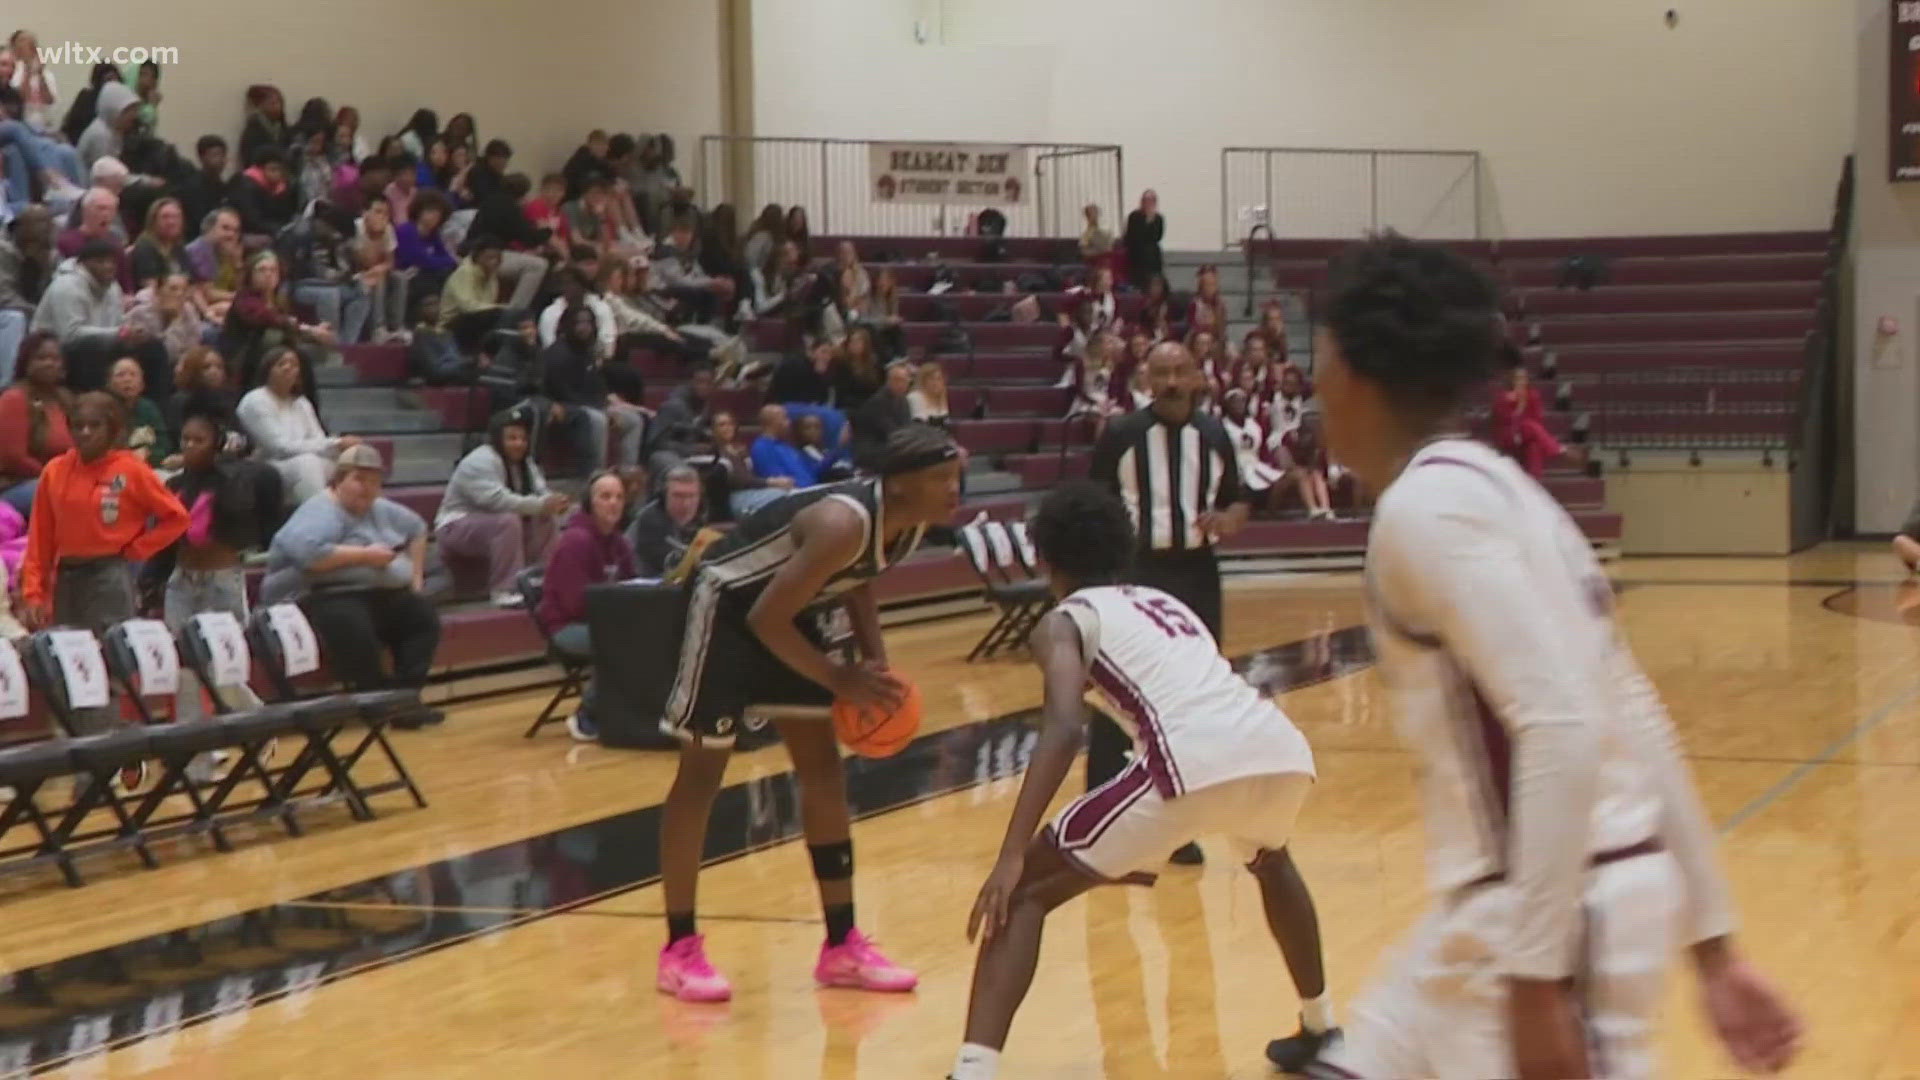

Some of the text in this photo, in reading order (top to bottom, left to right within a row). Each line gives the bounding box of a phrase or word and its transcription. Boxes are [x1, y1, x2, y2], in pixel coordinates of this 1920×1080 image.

[890, 151, 1010, 174] BEARCAT DEN
[900, 178, 999, 195] STUDENT SECTION
[1133, 599, 1200, 638] 15
